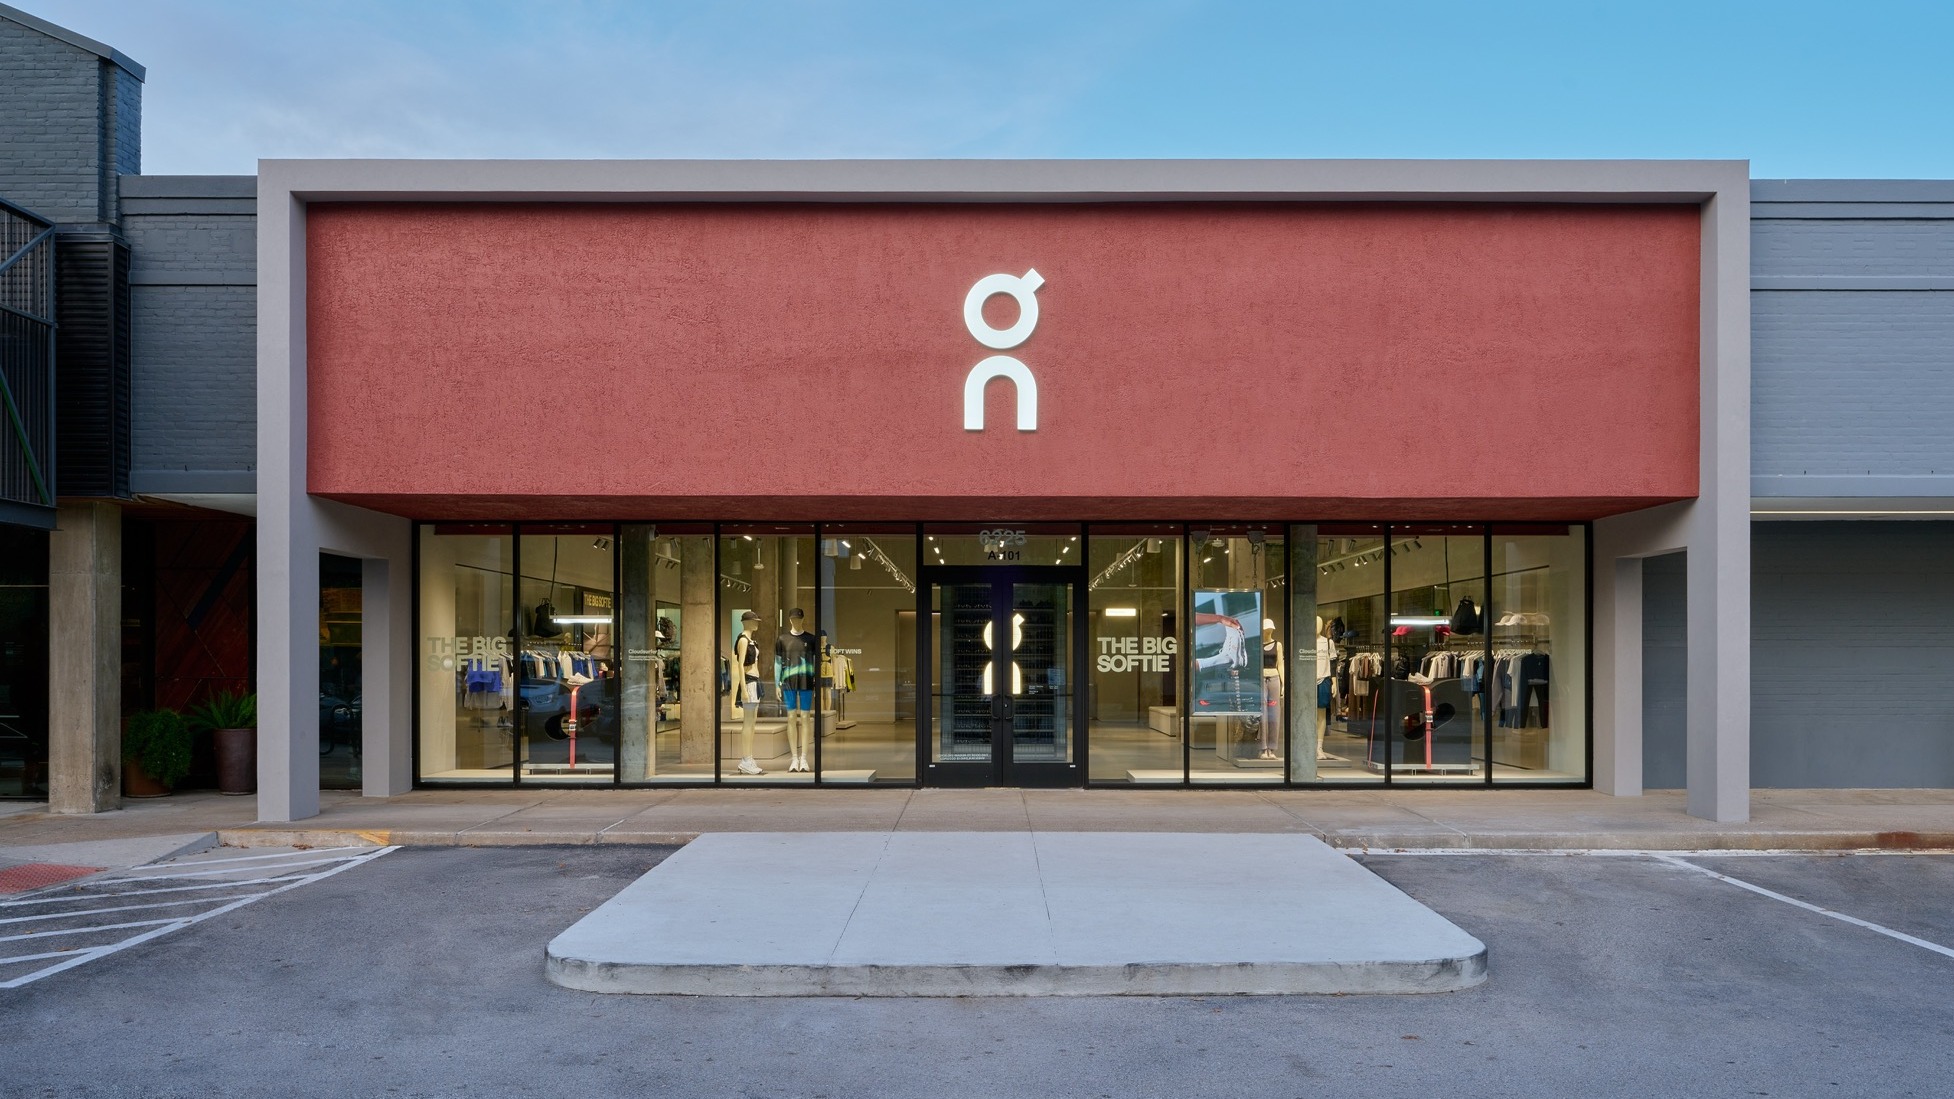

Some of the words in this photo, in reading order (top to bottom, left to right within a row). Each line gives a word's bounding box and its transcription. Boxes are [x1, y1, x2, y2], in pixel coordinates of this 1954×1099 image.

[427, 636, 468, 654] THE
[472, 636, 507, 654] BIG
[1097, 637, 1139, 654] THE
[1143, 637, 1178, 655] BIG
[427, 655, 500, 672] SOFTIE
[1097, 655, 1170, 673] SOFTIE
